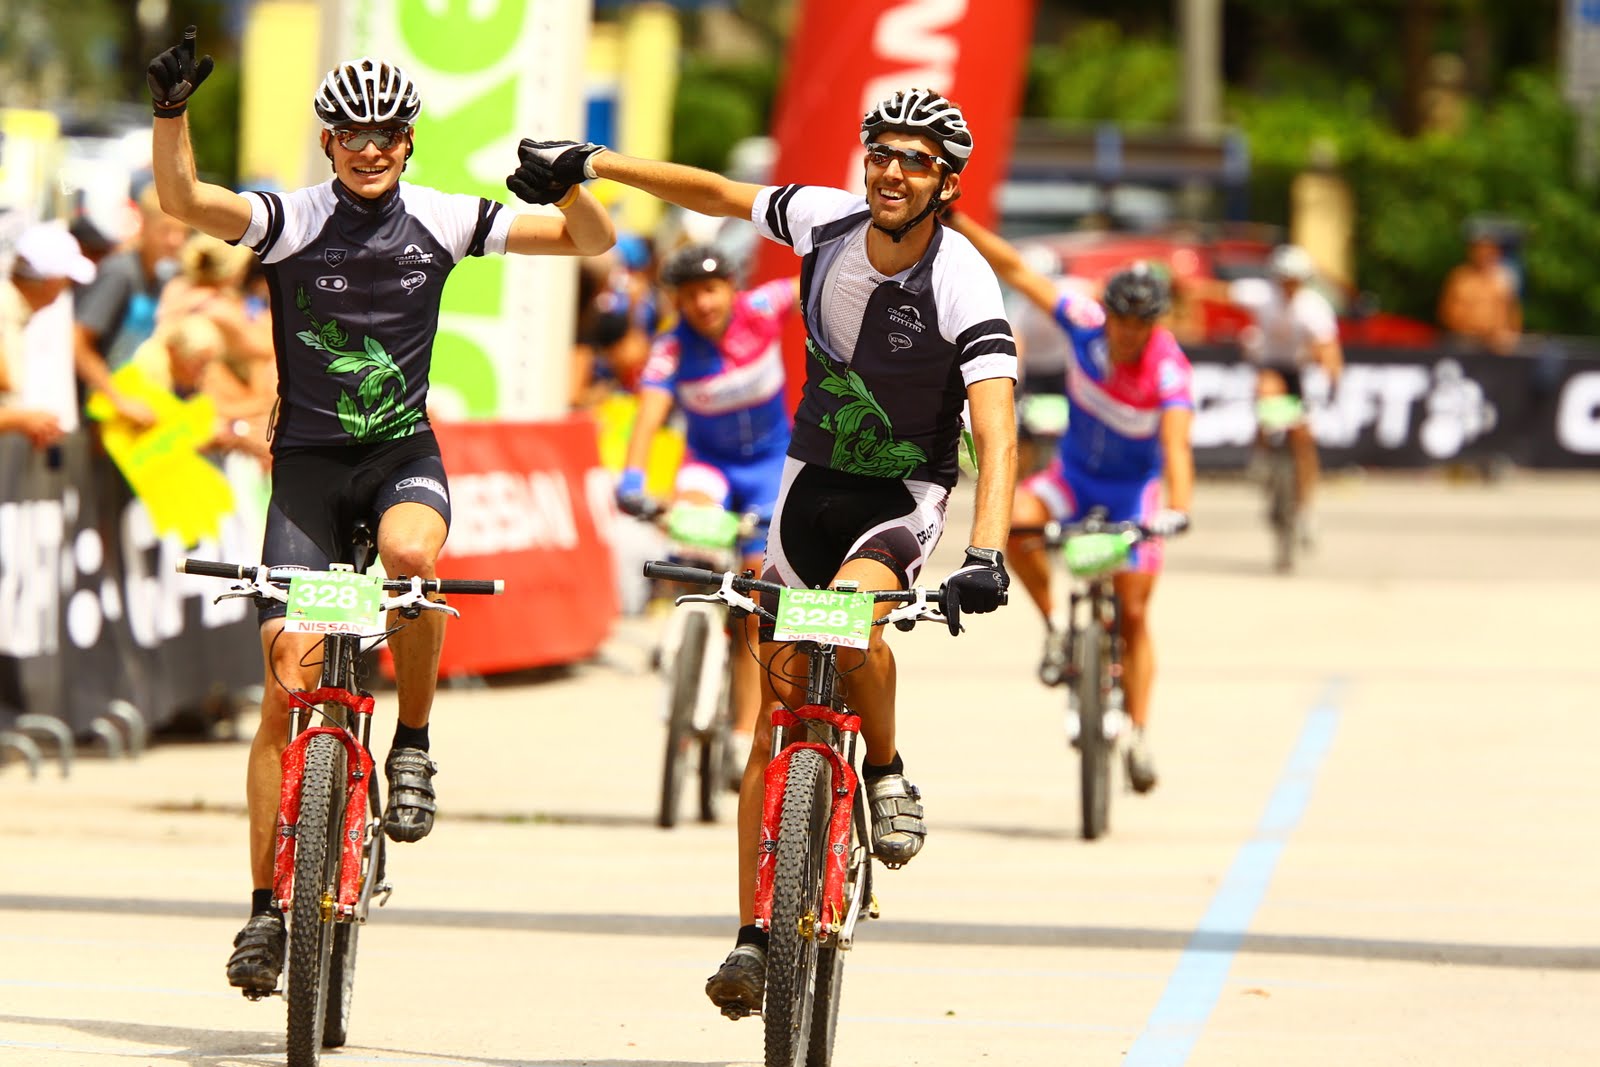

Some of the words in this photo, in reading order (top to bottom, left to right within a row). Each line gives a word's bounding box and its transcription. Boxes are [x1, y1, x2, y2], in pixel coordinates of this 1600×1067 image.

[887, 307, 909, 320] CRAFT
[916, 523, 935, 546] CRAFT
[295, 583, 358, 609] 328
[789, 591, 850, 607] CRAFT
[363, 599, 373, 612] 1
[784, 606, 849, 627] 328
[298, 622, 364, 634] NISSAN
[853, 620, 865, 628] 2
[788, 633, 856, 646] NISSAN
